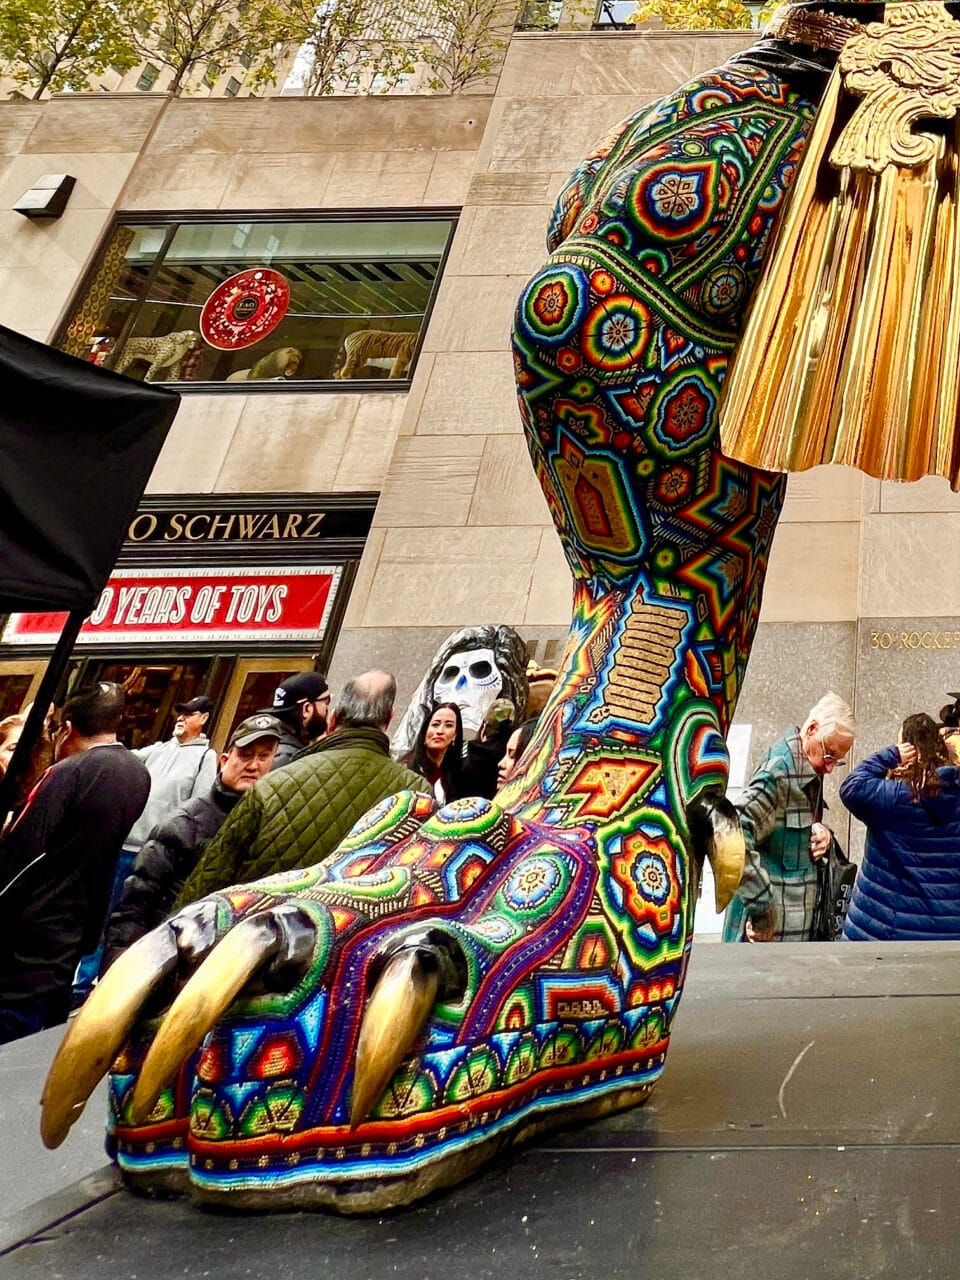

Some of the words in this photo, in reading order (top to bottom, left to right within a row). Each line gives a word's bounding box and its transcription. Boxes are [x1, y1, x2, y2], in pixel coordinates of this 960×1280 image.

[164, 513, 326, 540] SCHWARZ
[112, 585, 191, 625] YEARS
[190, 585, 227, 623] OF
[225, 584, 288, 622] TOYS
[870, 631, 892, 649] 30
